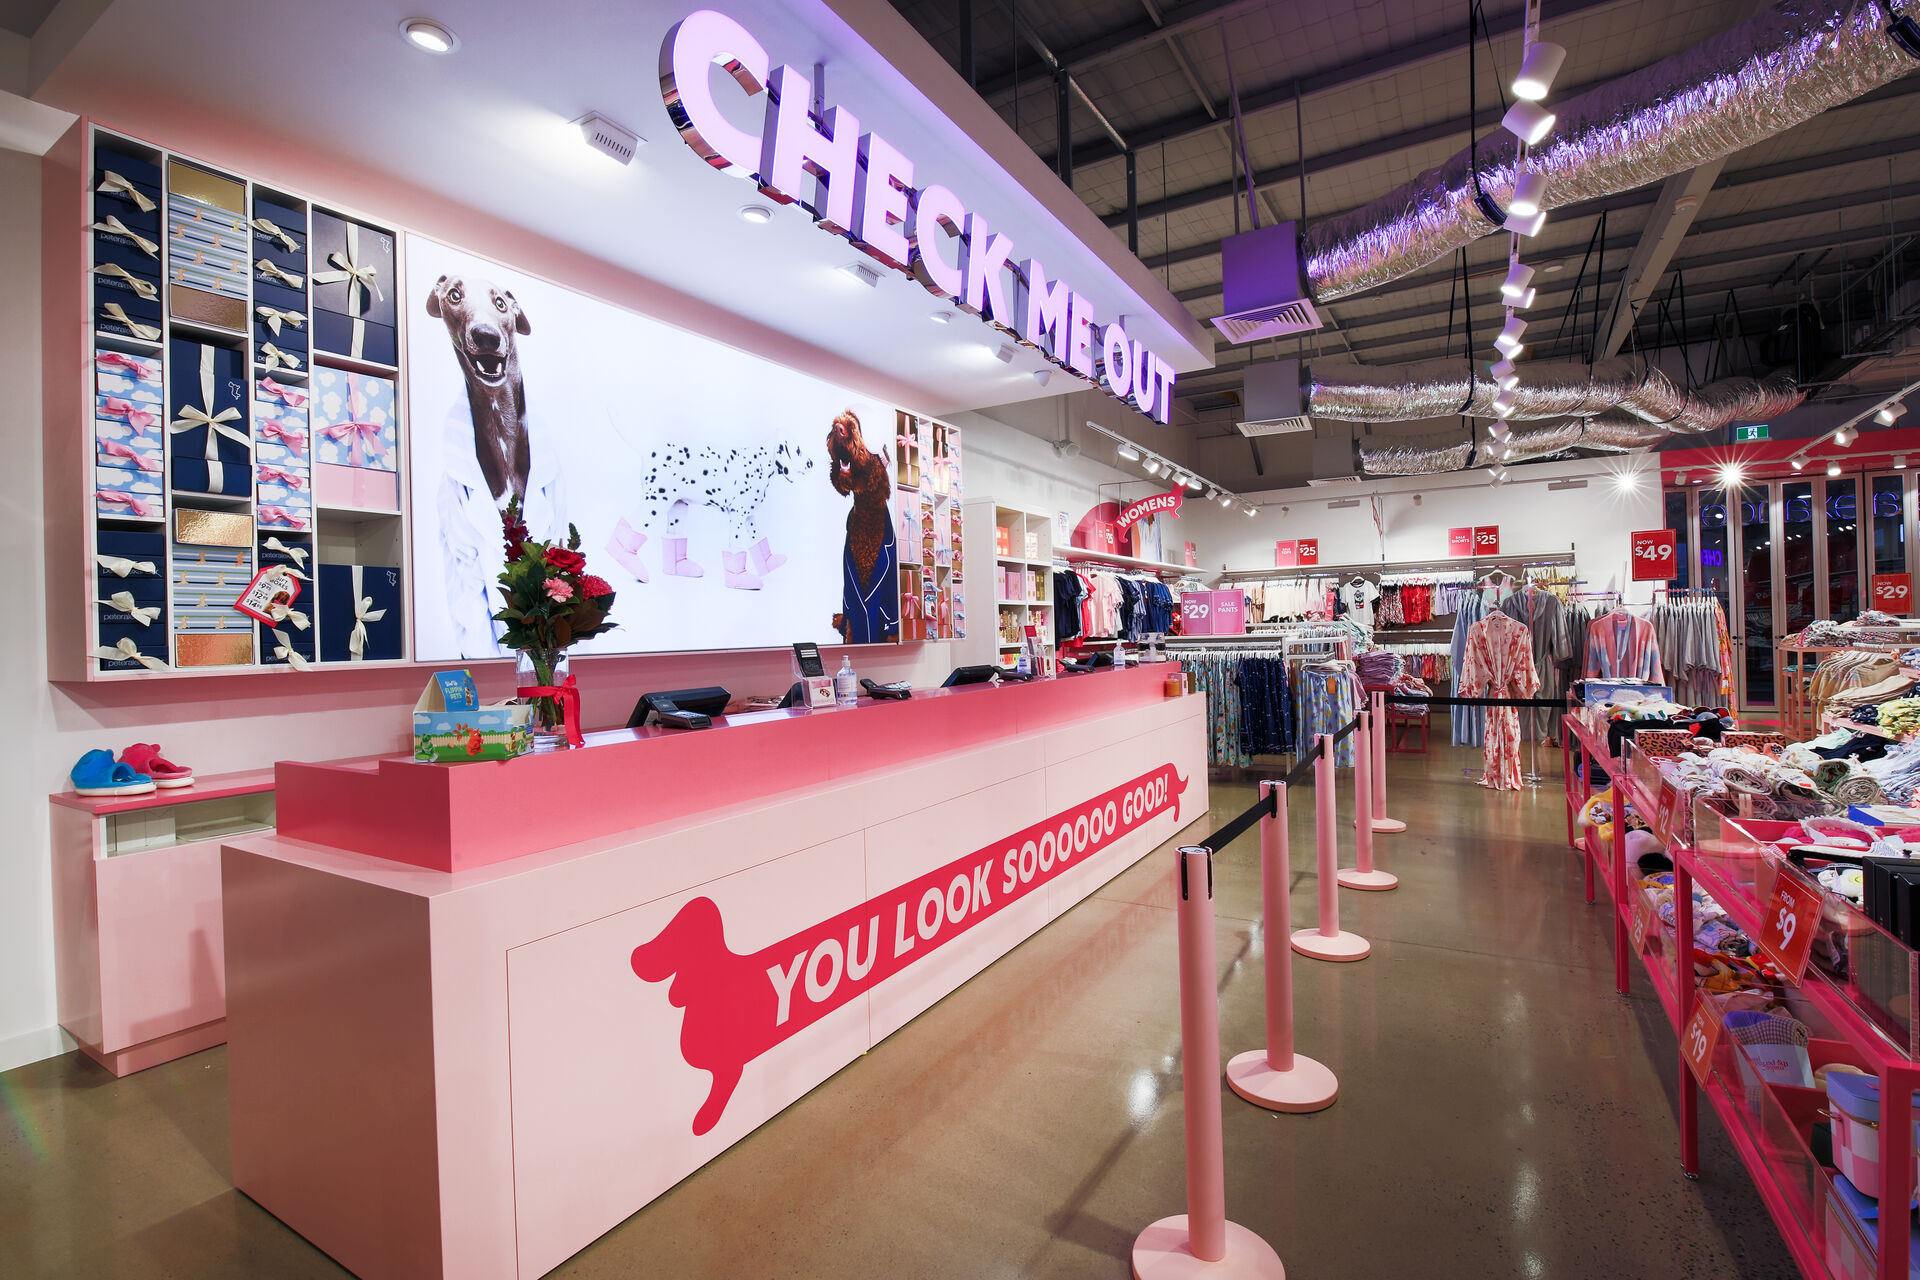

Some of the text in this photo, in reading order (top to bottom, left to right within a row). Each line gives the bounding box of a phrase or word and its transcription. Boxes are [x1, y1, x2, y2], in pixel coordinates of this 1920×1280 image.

[664, 9, 1177, 425] CHECK ME OUT
[1116, 496, 1176, 528] WOMENS
[1476, 534, 1496, 545] $25
[1299, 546, 1316, 556] $25
[1635, 544, 1672, 561] $49
[1875, 585, 1909, 599] $29
[1183, 604, 1209, 619] $29
[766, 773, 1170, 1028] YOU LOOK SOOOOOO GOOD!
[1780, 890, 1796, 909] FROM
[1776, 907, 1796, 951] $9
[1690, 1022, 1707, 1063] $19
